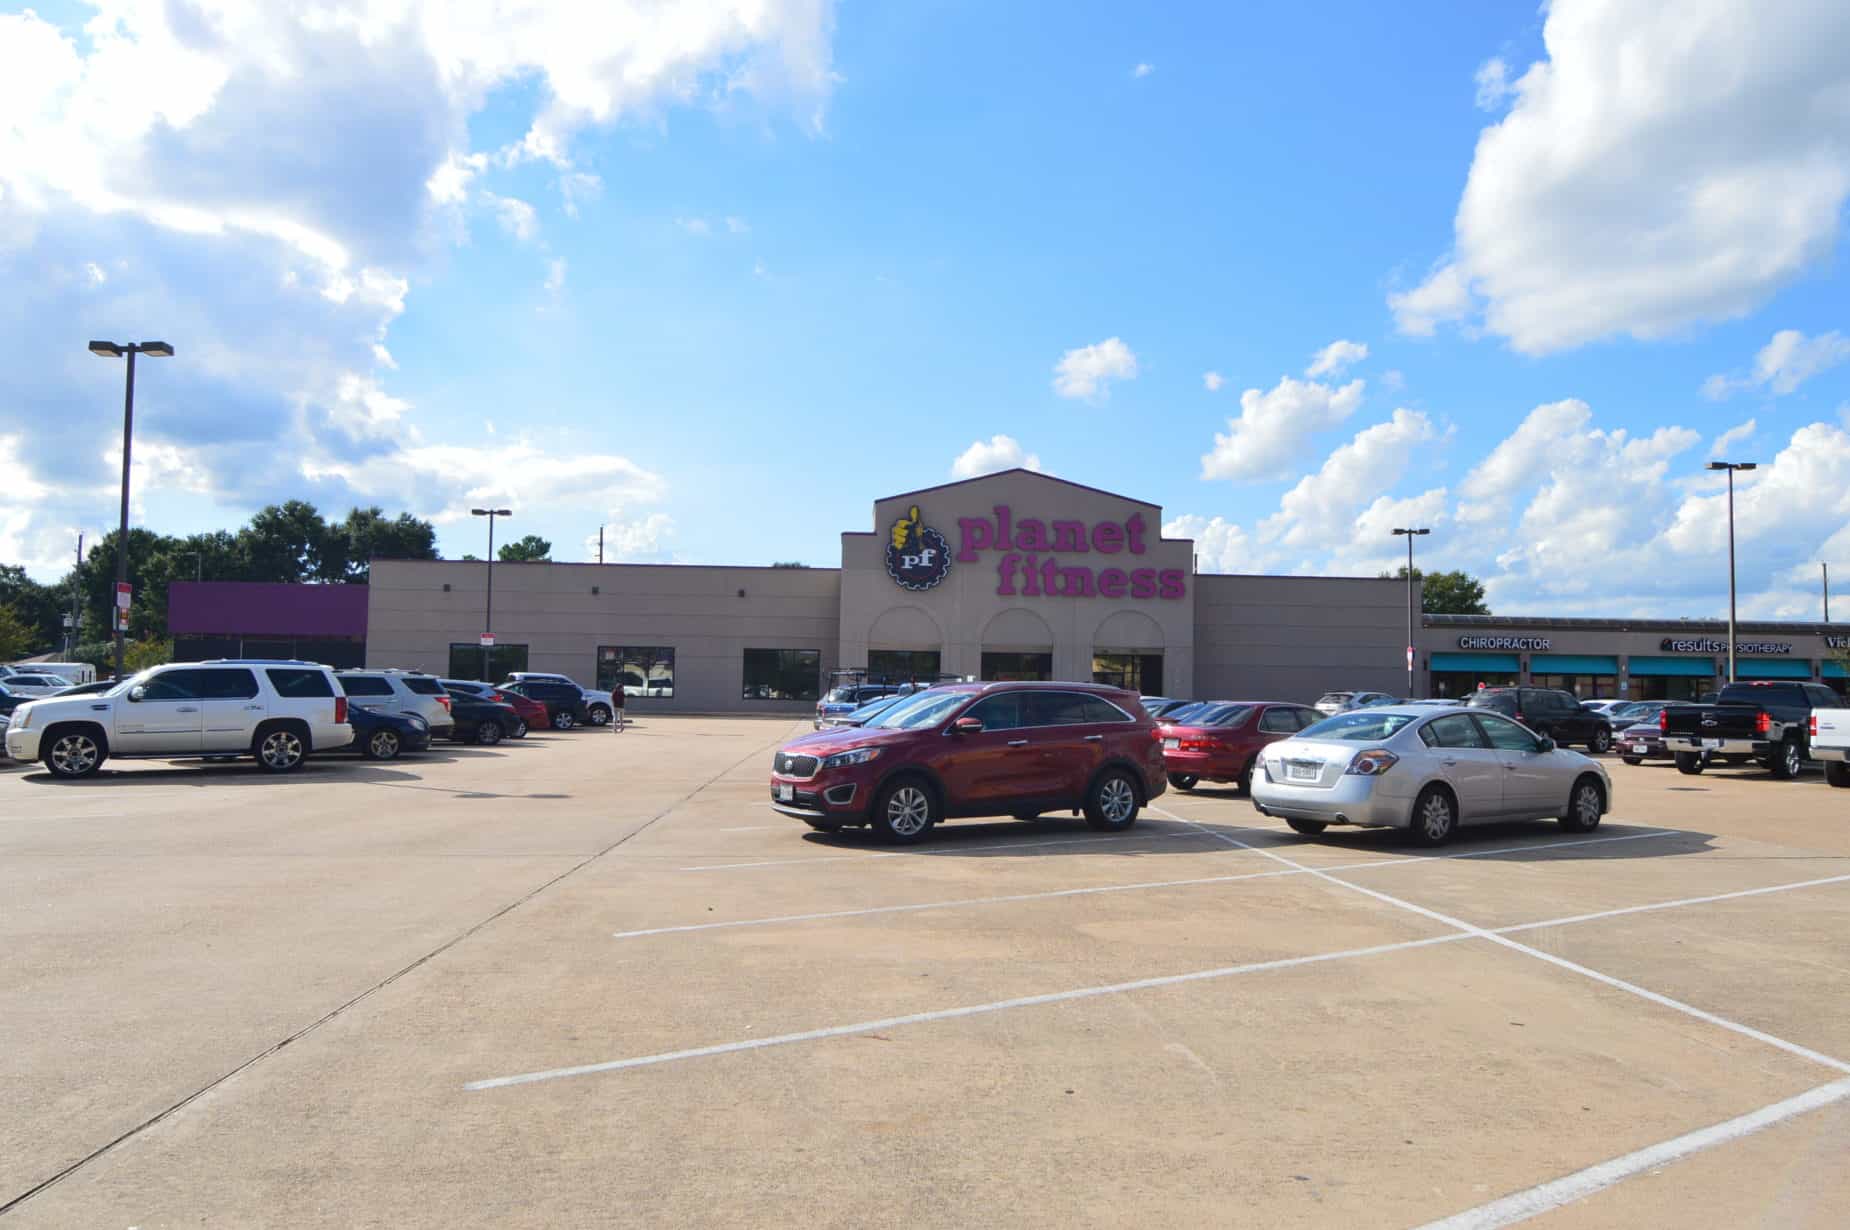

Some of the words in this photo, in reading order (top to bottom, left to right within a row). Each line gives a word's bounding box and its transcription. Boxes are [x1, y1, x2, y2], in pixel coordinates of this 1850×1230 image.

[957, 505, 1146, 562] planet
[901, 549, 936, 569] pf
[996, 553, 1186, 599] fitness
[1460, 637, 1550, 650] CHIROPRACTOR
[1672, 638, 1720, 652] results
